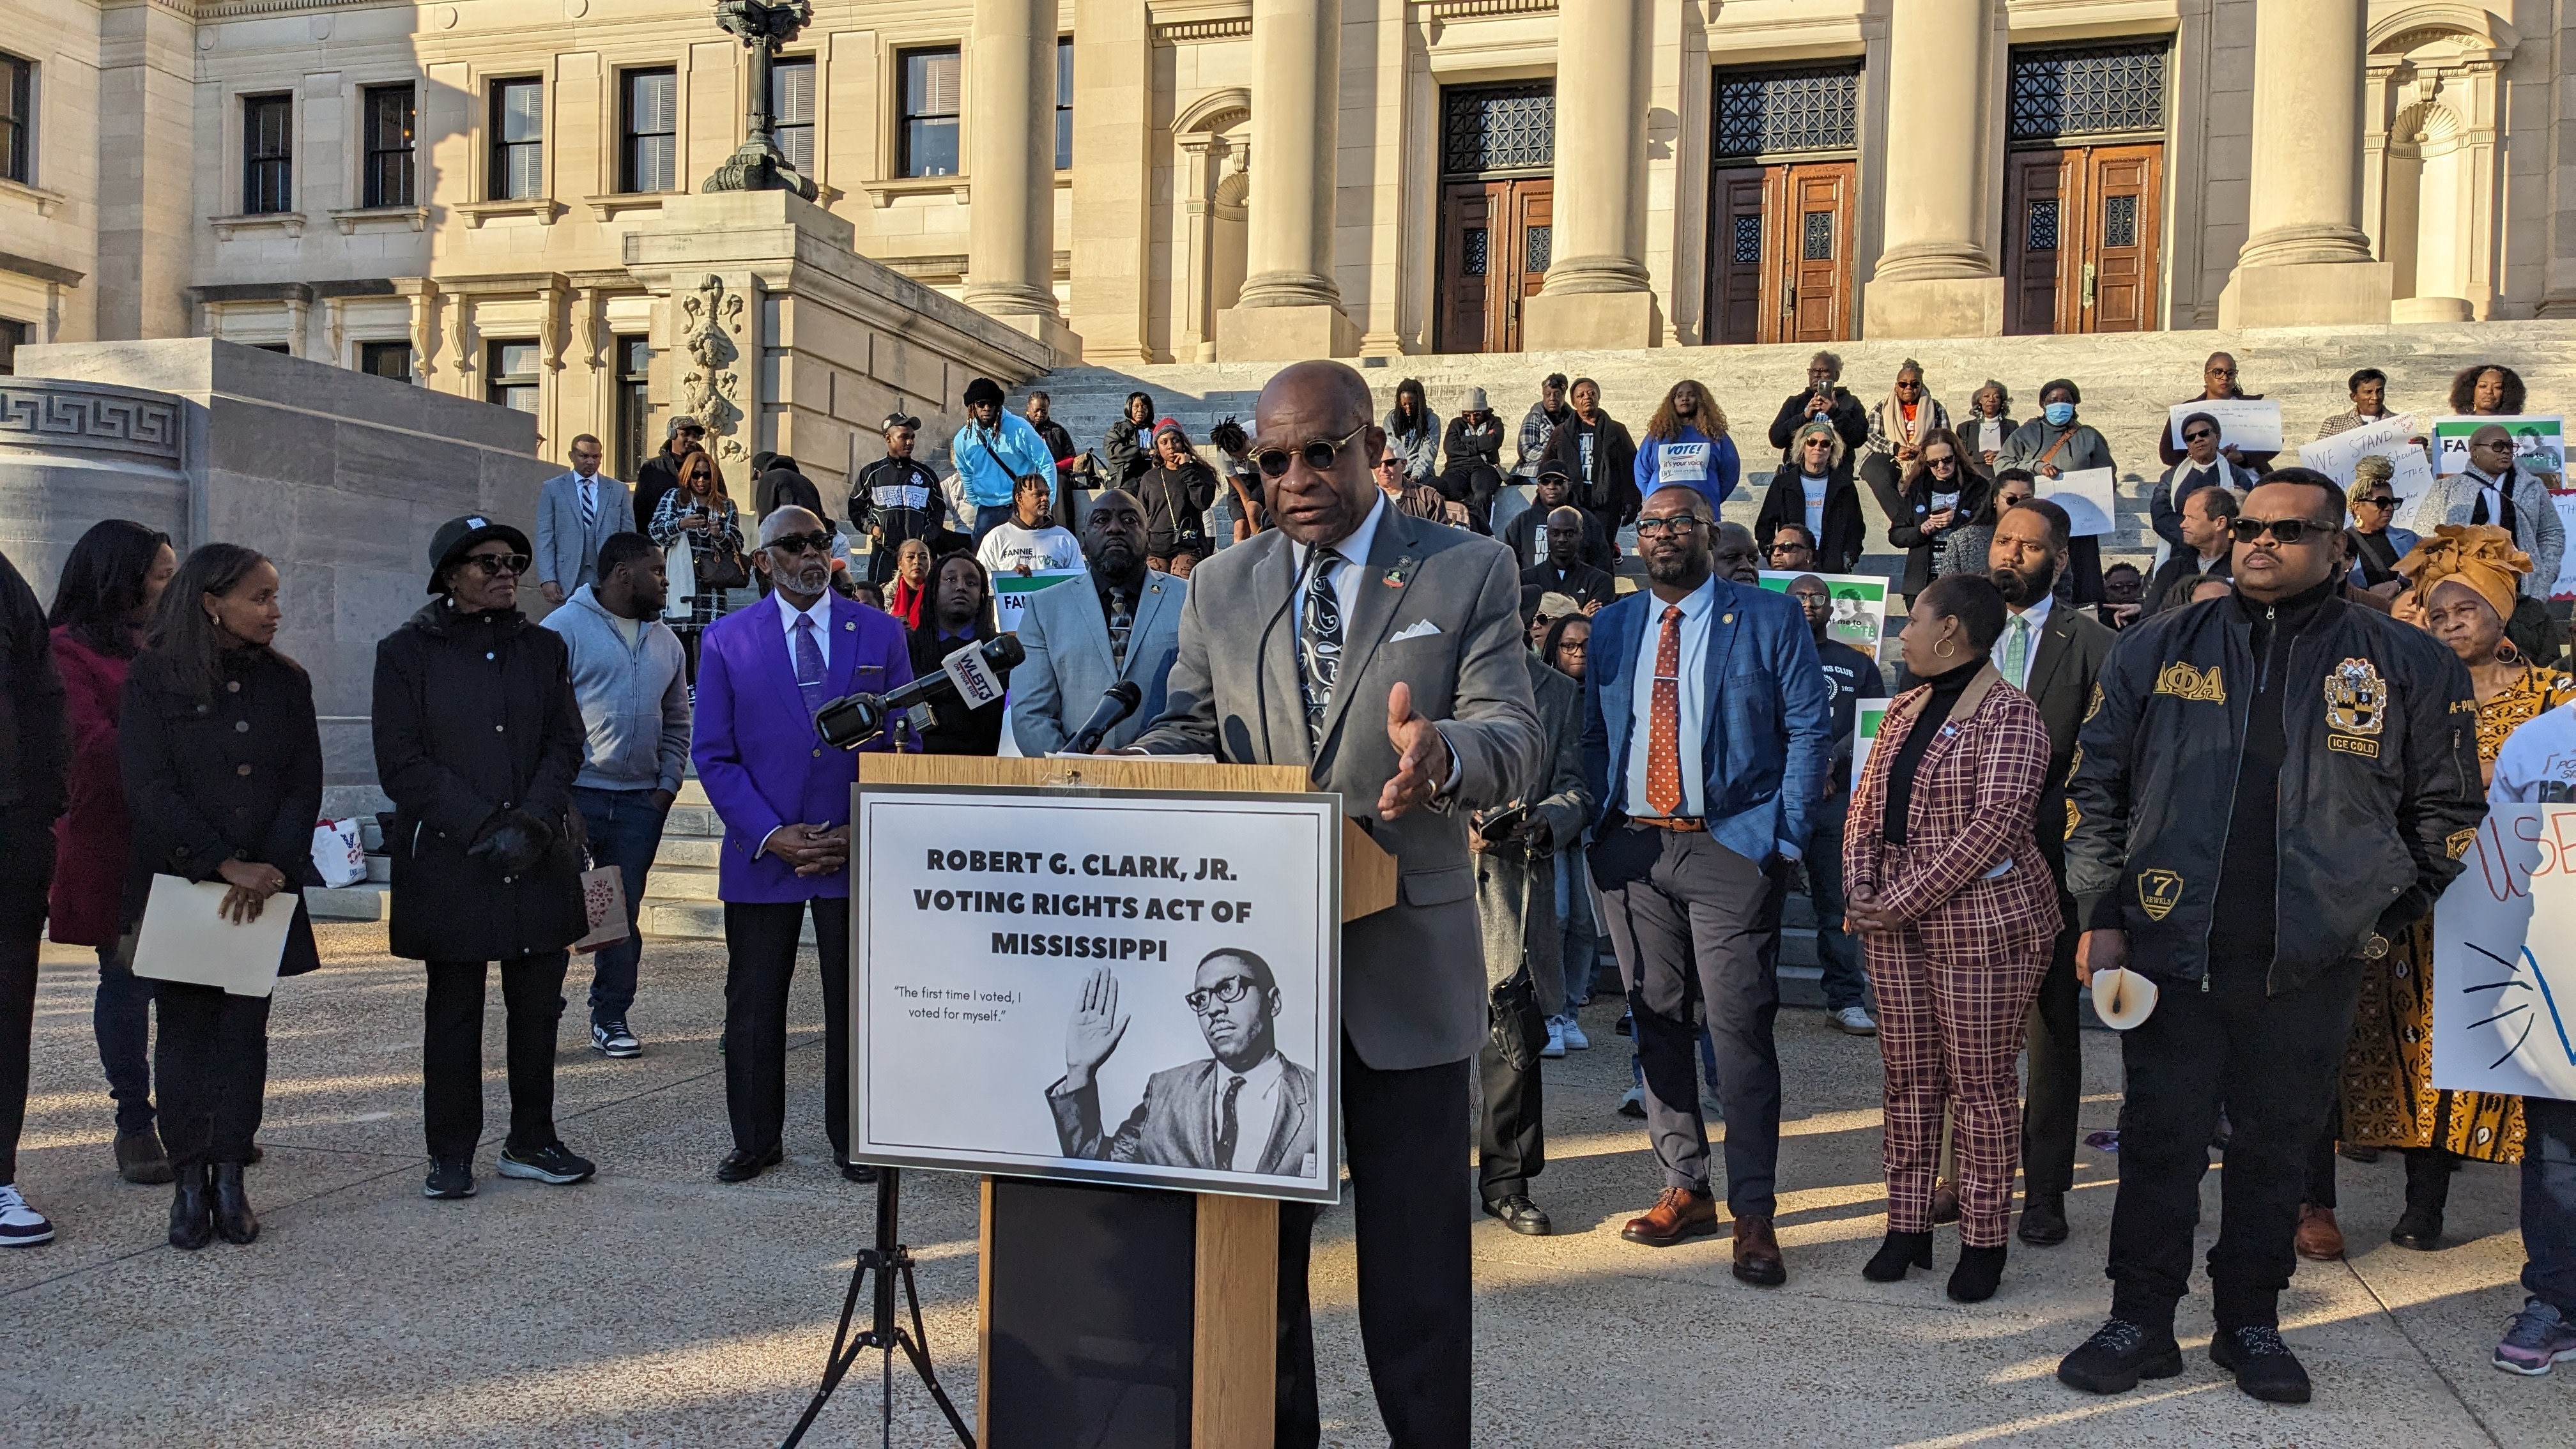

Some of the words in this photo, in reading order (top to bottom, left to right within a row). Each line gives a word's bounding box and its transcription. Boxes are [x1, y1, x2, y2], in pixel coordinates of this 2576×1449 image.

[1667, 444, 1703, 455] VOTE!
[2308, 449, 2338, 471] WE
[2349, 431, 2393, 458] STAND
[2403, 467, 2424, 479] THE
[877, 490, 901, 501] RICH
[905, 491, 926, 502] OFF
[1003, 548, 1033, 559] FANNIE
[1834, 666, 1854, 677] CLUB
[953, 663, 962, 672] ON
[958, 671, 970, 686] YOUR
[967, 686, 977, 698] SIDE
[2333, 738, 2349, 749] ICE
[2350, 741, 2375, 753] COLD
[927, 848, 1043, 874] ROBERT
[1048, 853, 1075, 875] G.
[1082, 854, 1188, 882] CLARK,
[1194, 857, 1238, 880] JR.
[2153, 876, 2174, 896] 7
[913, 889, 1025, 914] VOTING
[1032, 894, 1138, 919] RIGHTS
[1144, 898, 1205, 922] ACT
[1211, 901, 1252, 924] OF
[2145, 895, 2172, 905] JEWELS
[992, 932, 1167, 962] MISSISSIPPI
[922, 986, 942, 999] first
[946, 990, 970, 1000] time
[980, 990, 1015, 1004] voted,
[908, 1007, 940, 1018] voted
[944, 1008, 960, 1020] for
